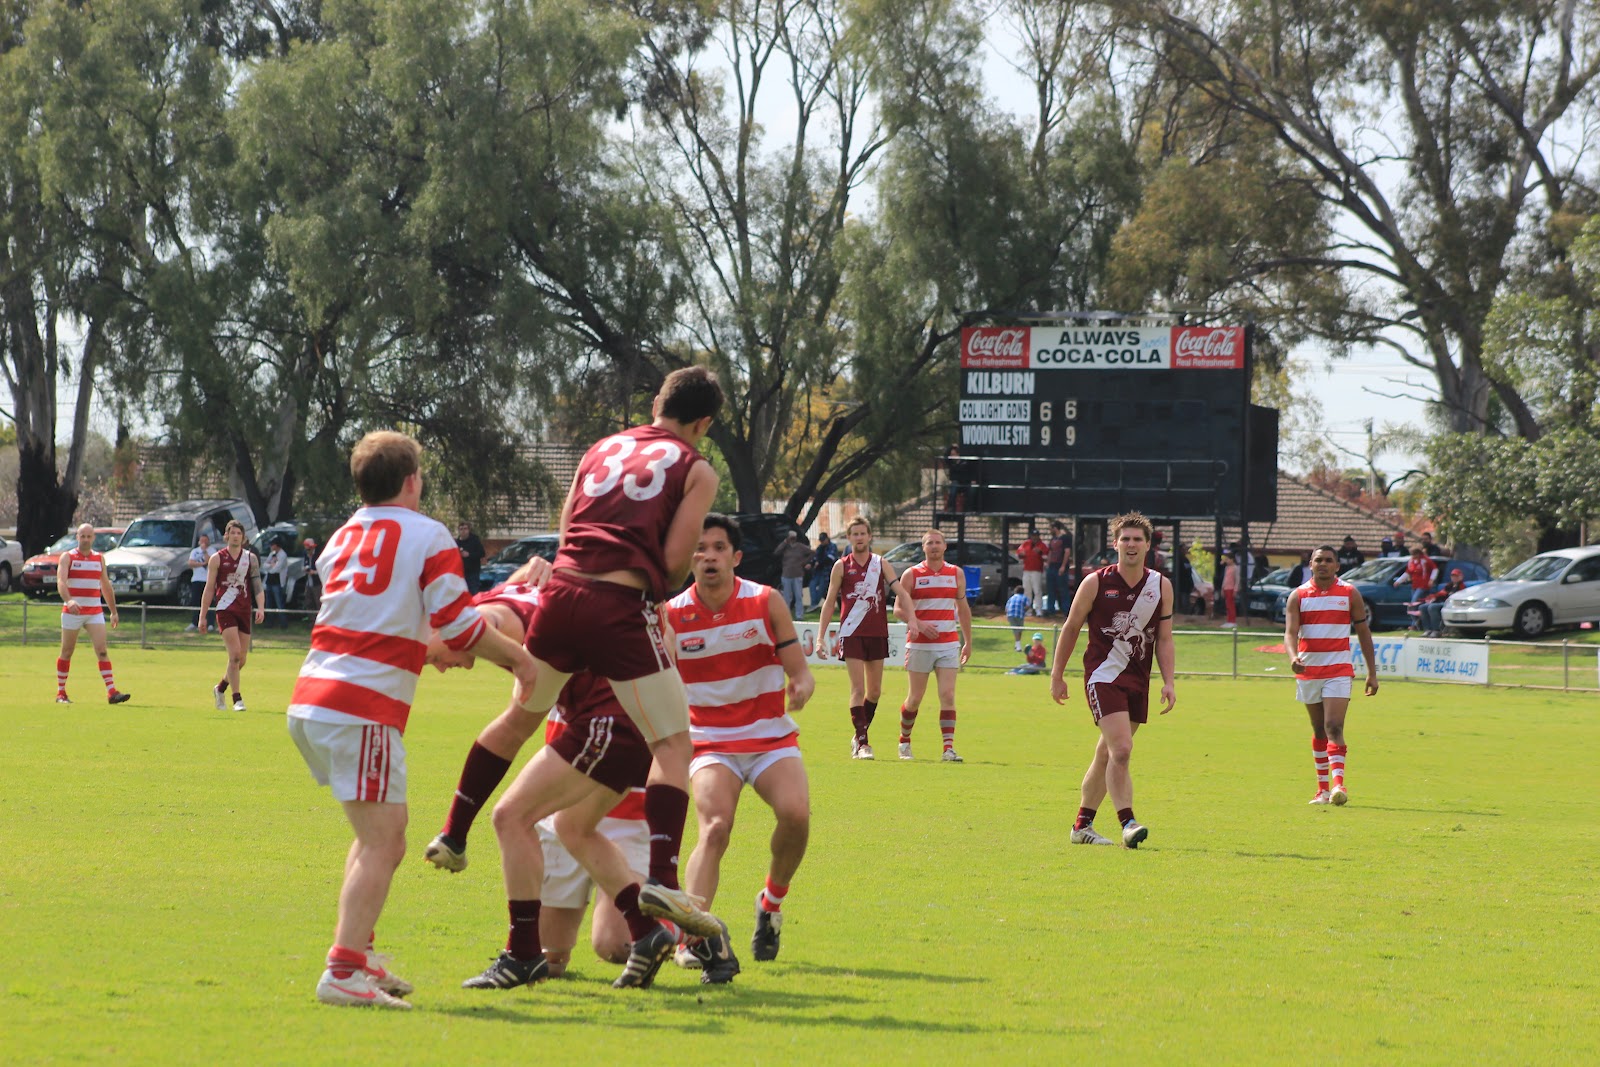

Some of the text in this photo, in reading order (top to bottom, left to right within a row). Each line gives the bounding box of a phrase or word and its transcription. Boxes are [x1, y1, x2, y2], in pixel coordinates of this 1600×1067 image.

[967, 330, 1025, 357] Coca-Cola
[1059, 331, 1140, 345] ALWAYS
[1176, 330, 1236, 357] Coca-Cola
[967, 358, 1022, 366] Real Refreshment
[1037, 349, 1162, 363] COCA-COLA
[1176, 358, 1235, 366] Real Refreshment
[967, 372, 1035, 394] KILBURN
[962, 403, 1028, 418] COL LIGHT GDNS
[1040, 402, 1052, 421] 6
[1065, 400, 1077, 419] 6
[962, 425, 1030, 445] WOODVILLE STH
[1041, 426, 1051, 446] 9
[1066, 426, 1076, 446] 9
[583, 434, 680, 501] 33
[325, 518, 402, 596] 29
[1416, 658, 1479, 676] PH: 8244 4437
